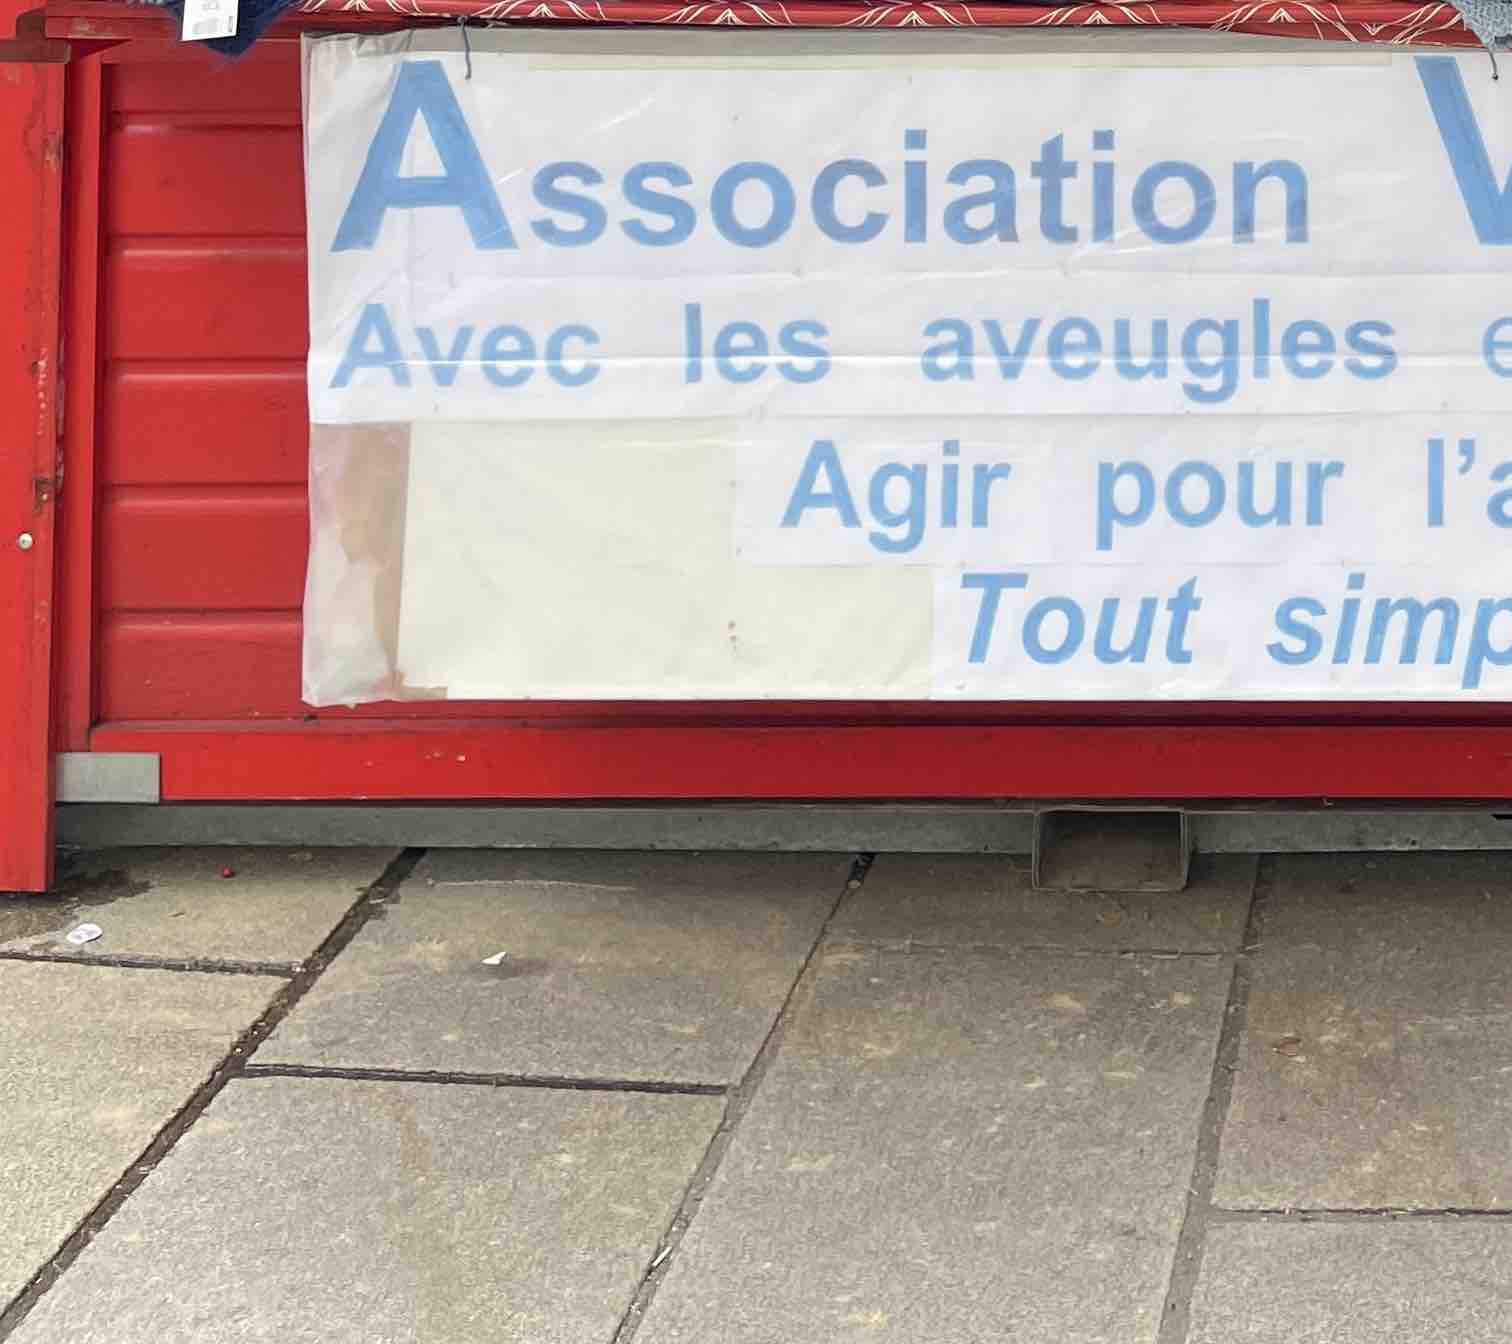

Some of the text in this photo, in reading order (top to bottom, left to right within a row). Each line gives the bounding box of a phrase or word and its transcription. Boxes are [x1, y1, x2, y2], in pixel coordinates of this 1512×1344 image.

[333, 60, 1308, 250] Association
[330, 303, 600, 389] Avec
[685, 303, 832, 384] les
[922, 298, 1397, 404] aveugles
[781, 440, 1010, 552] Agir
[1097, 460, 1345, 552] pour
[959, 572, 1202, 666] Tout
